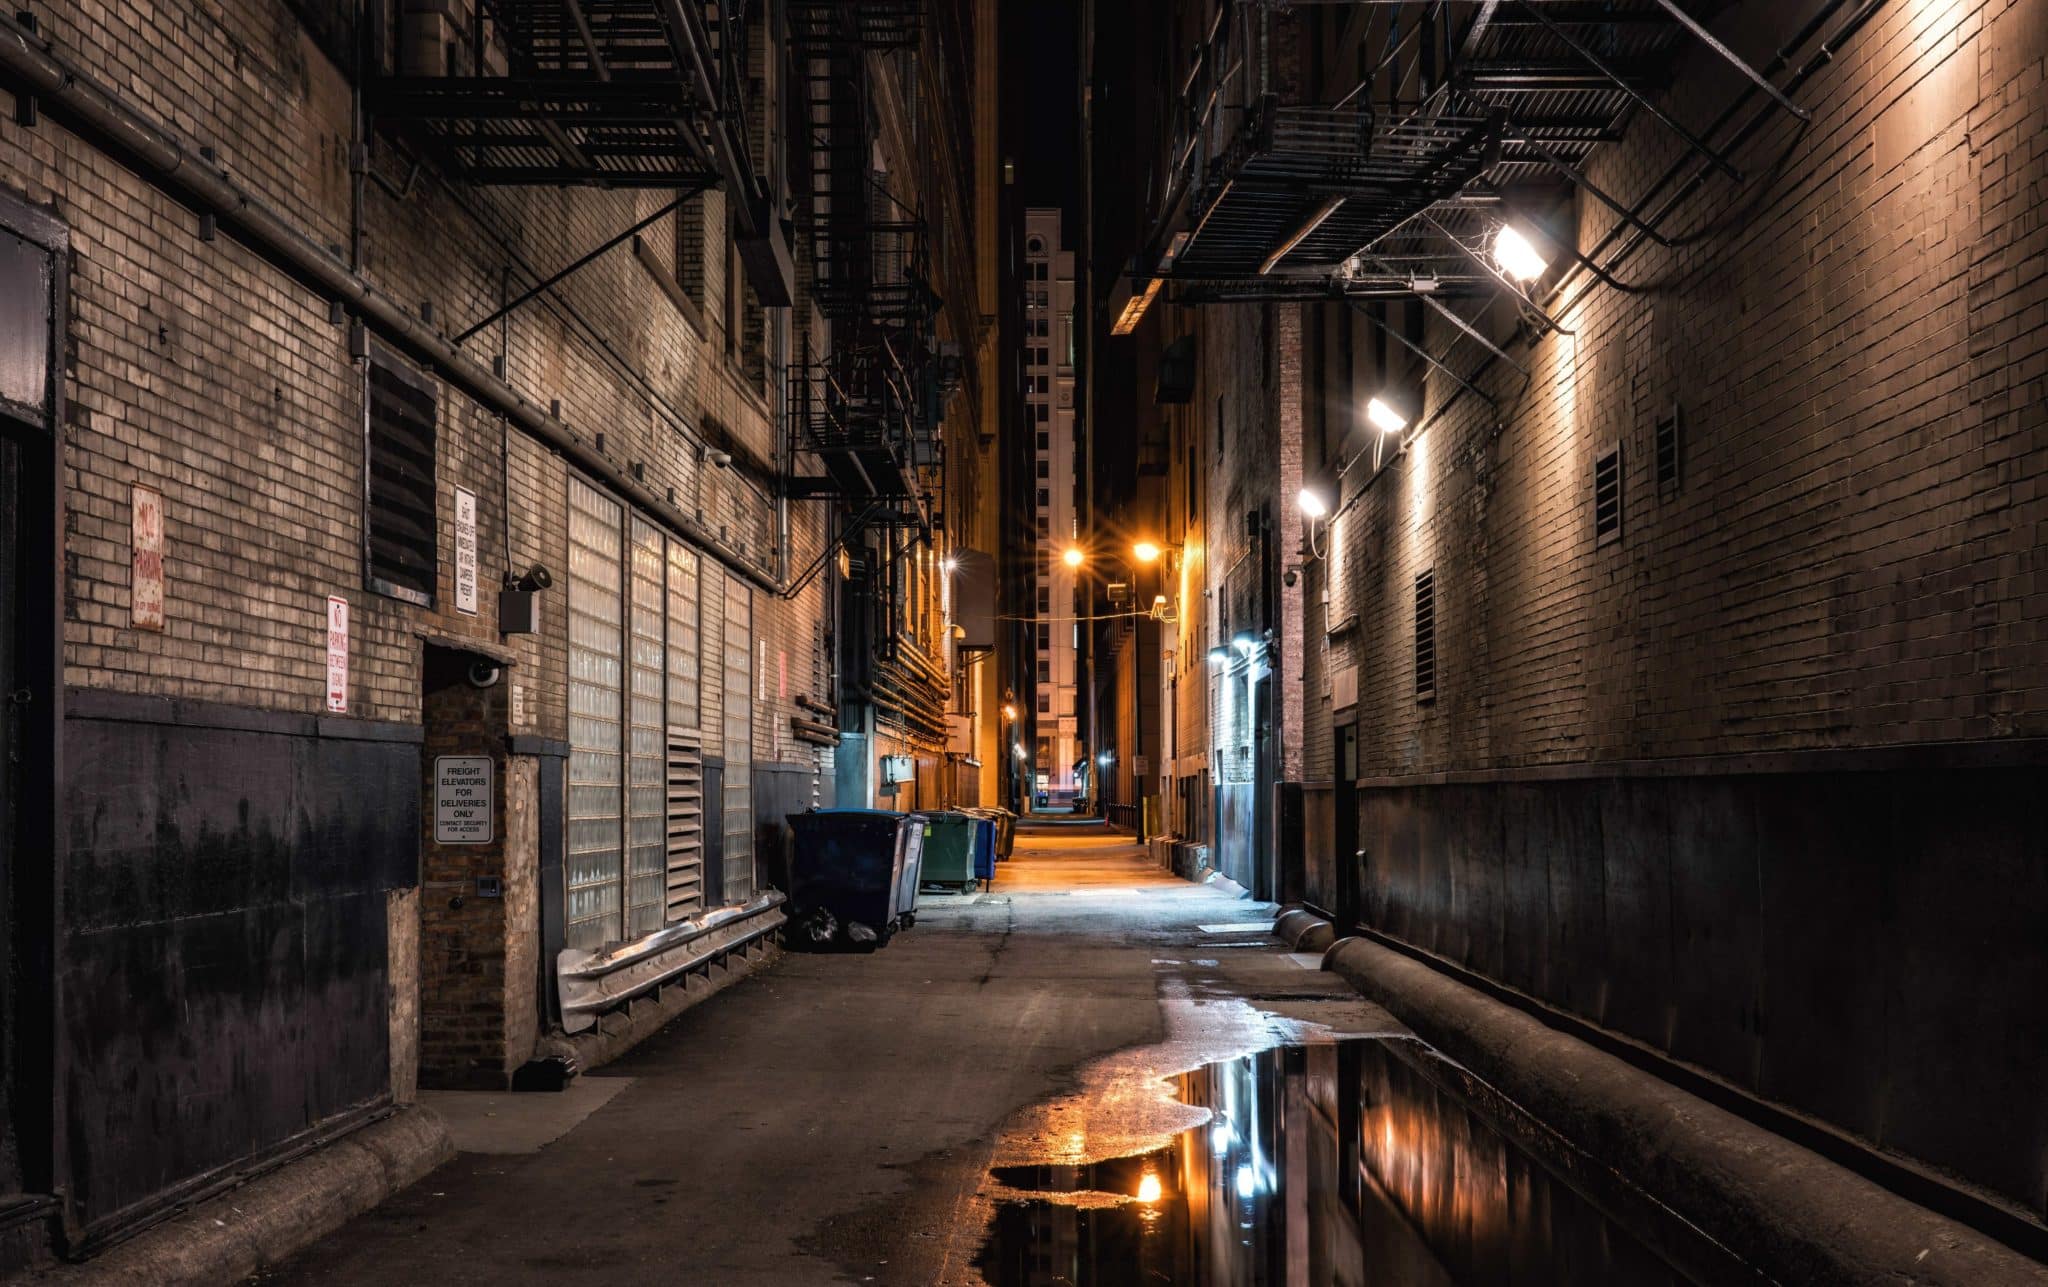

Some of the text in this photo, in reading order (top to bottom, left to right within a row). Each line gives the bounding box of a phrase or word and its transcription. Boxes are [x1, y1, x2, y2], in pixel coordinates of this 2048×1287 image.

[138, 501, 155, 538] NO
[135, 547, 162, 582] PARKING
[333, 607, 342, 628] NO
[329, 630, 346, 652] PARKING
[447, 767, 481, 776] FREIGHT
[441, 778, 486, 786] ELEVATORS
[455, 788, 473, 796] FOR
[440, 799, 487, 807] DELIVERIES
[453, 810, 474, 818] ONLY
